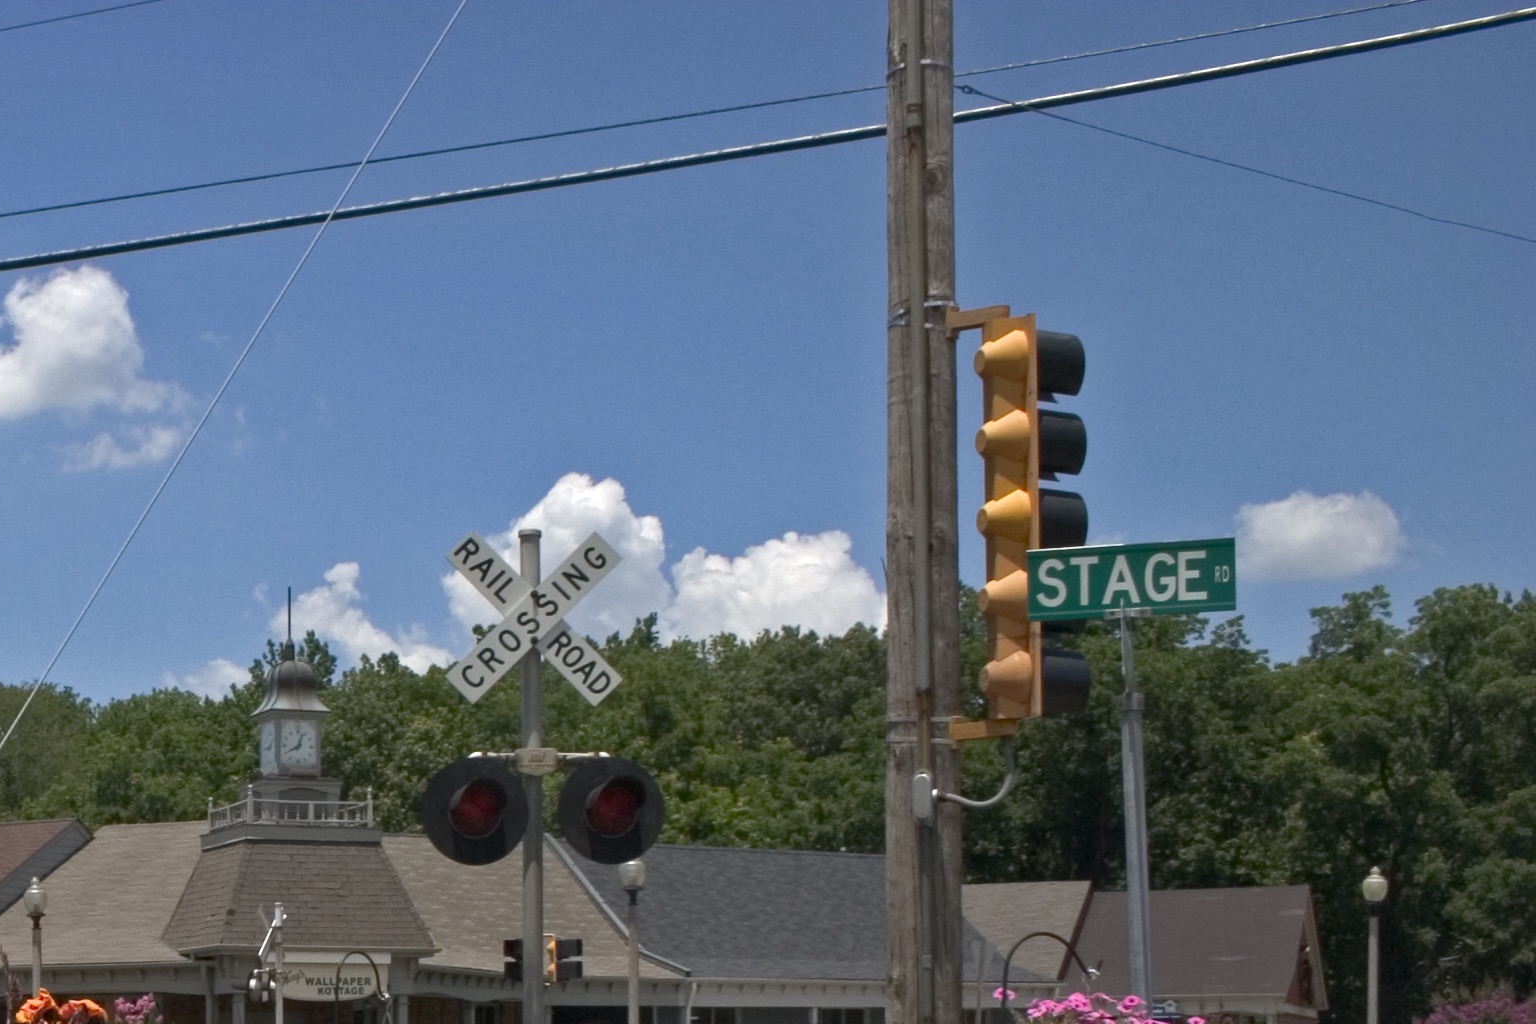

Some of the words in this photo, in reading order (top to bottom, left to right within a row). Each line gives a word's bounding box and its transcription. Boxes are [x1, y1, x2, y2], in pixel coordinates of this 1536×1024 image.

[454, 537, 513, 604] RAIL
[547, 630, 611, 694] ROAD
[461, 547, 607, 688] CROSSING
[1036, 550, 1208, 608] STAGE
[1214, 565, 1230, 583] RD
[305, 977, 371, 986] WALLPAPER
